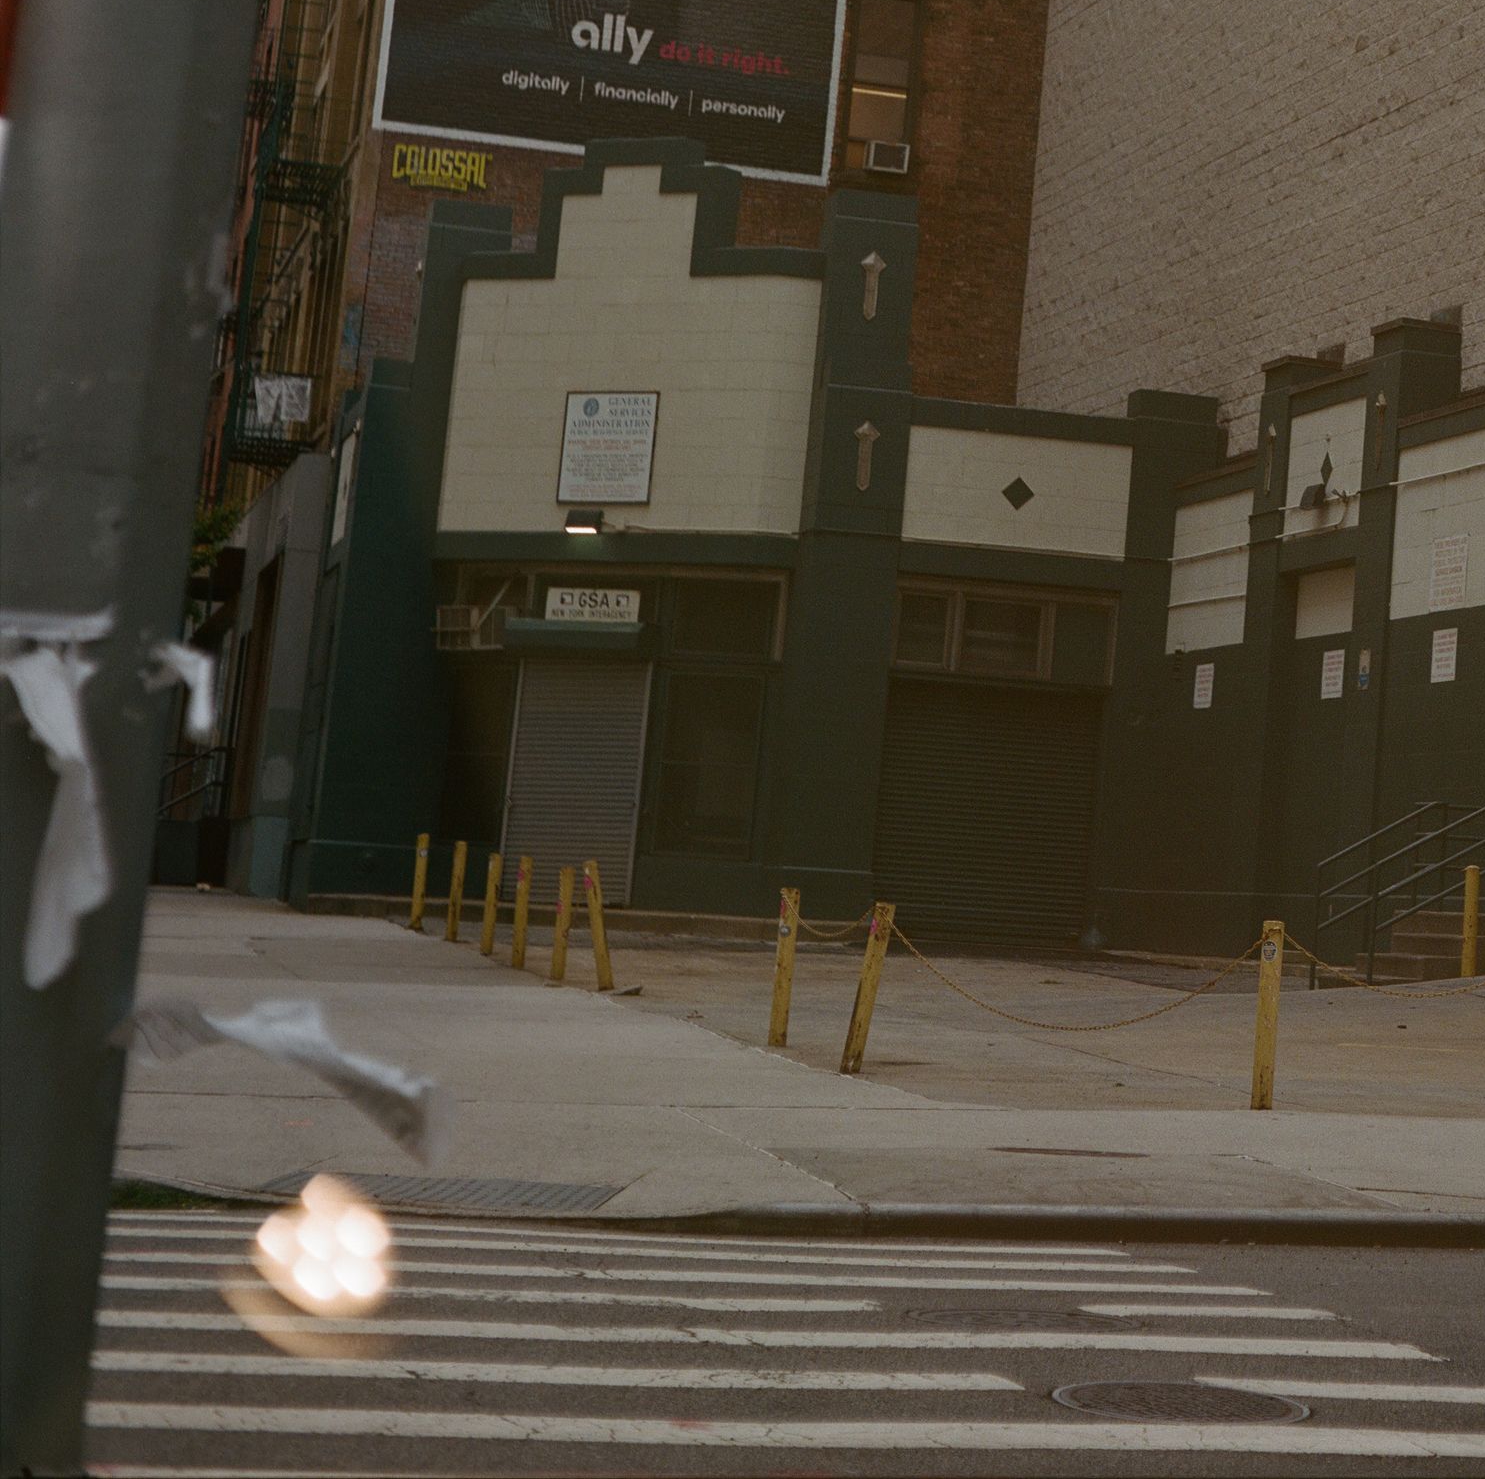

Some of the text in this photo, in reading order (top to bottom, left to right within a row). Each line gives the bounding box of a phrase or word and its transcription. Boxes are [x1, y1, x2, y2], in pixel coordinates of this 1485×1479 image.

[571, 12, 791, 75] ally do it right.
[502, 70, 786, 124] digitally financially personally
[391, 142, 489, 190] COLOSSAL
[608, 397, 651, 407] GENERAL
[609, 408, 652, 418] SERVICES
[578, 591, 610, 609] GSA
[551, 608, 565, 618] NEW
